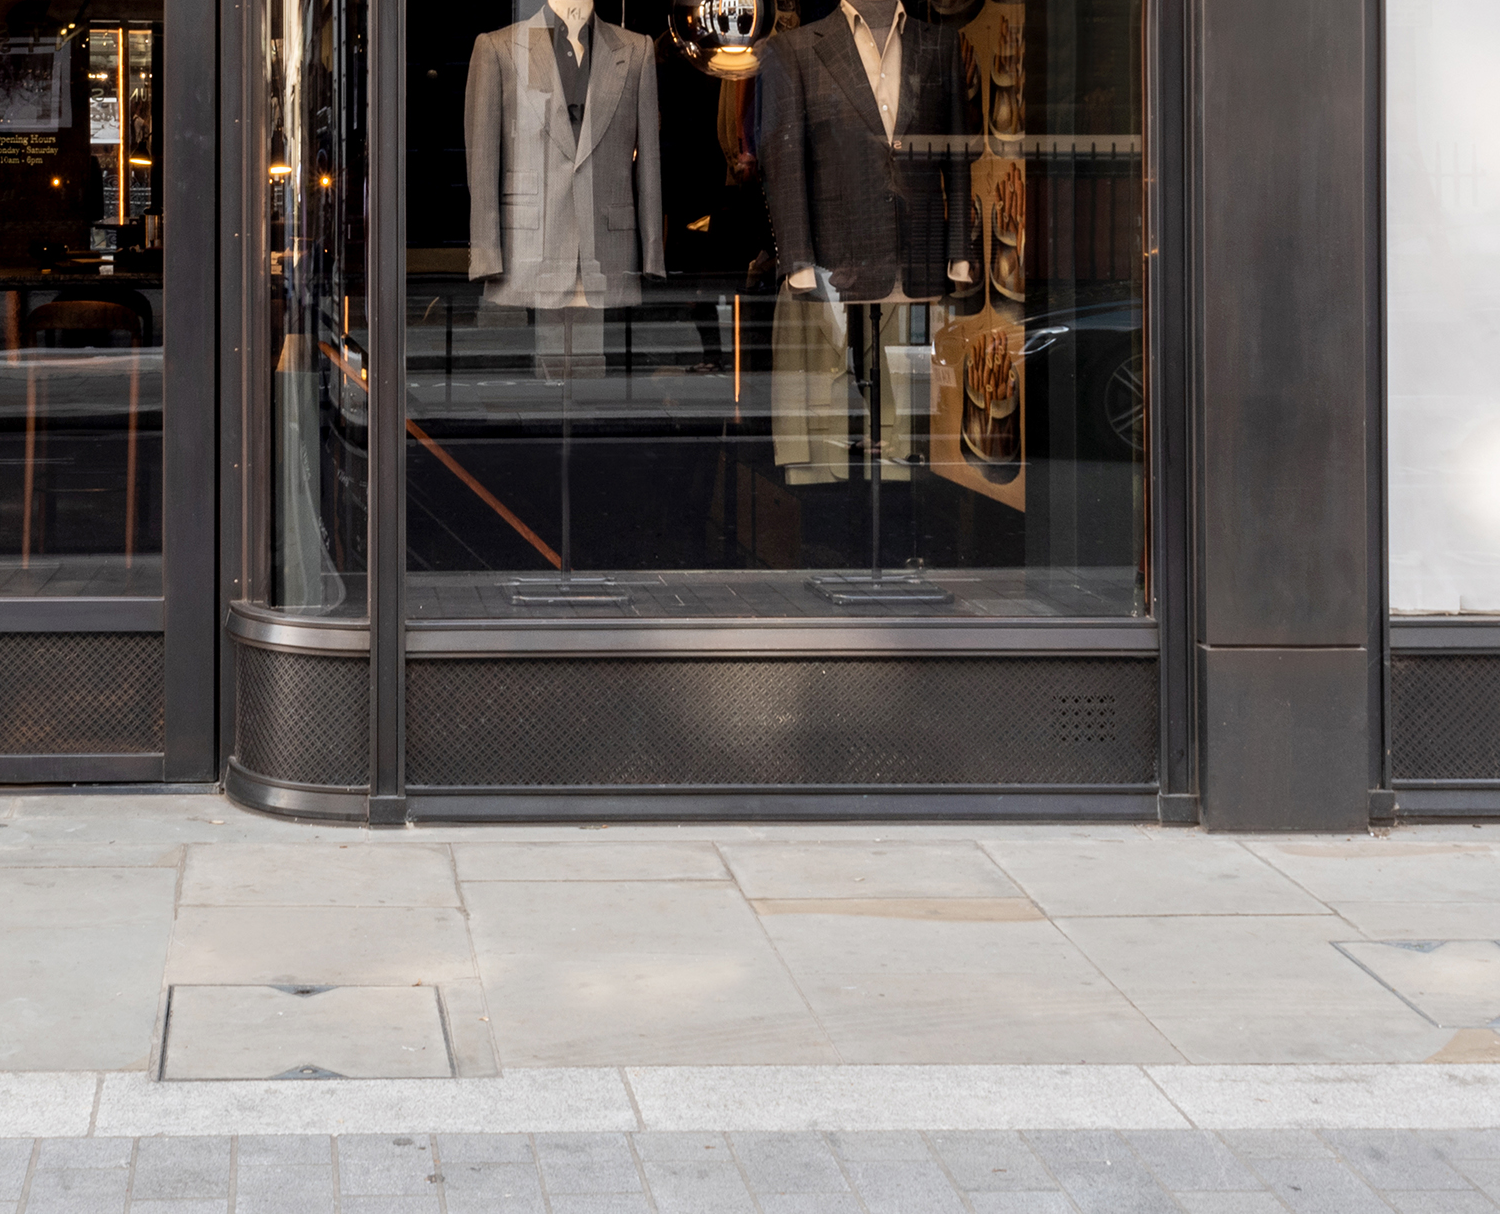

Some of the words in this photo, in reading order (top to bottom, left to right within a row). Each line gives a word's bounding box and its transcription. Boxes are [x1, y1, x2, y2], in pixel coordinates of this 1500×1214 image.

[30, 134, 57, 144] Hours
[26, 145, 59, 156] Saturday
[0, 156, 20, 164] 10am
[26, 156, 43, 166] 6pm
